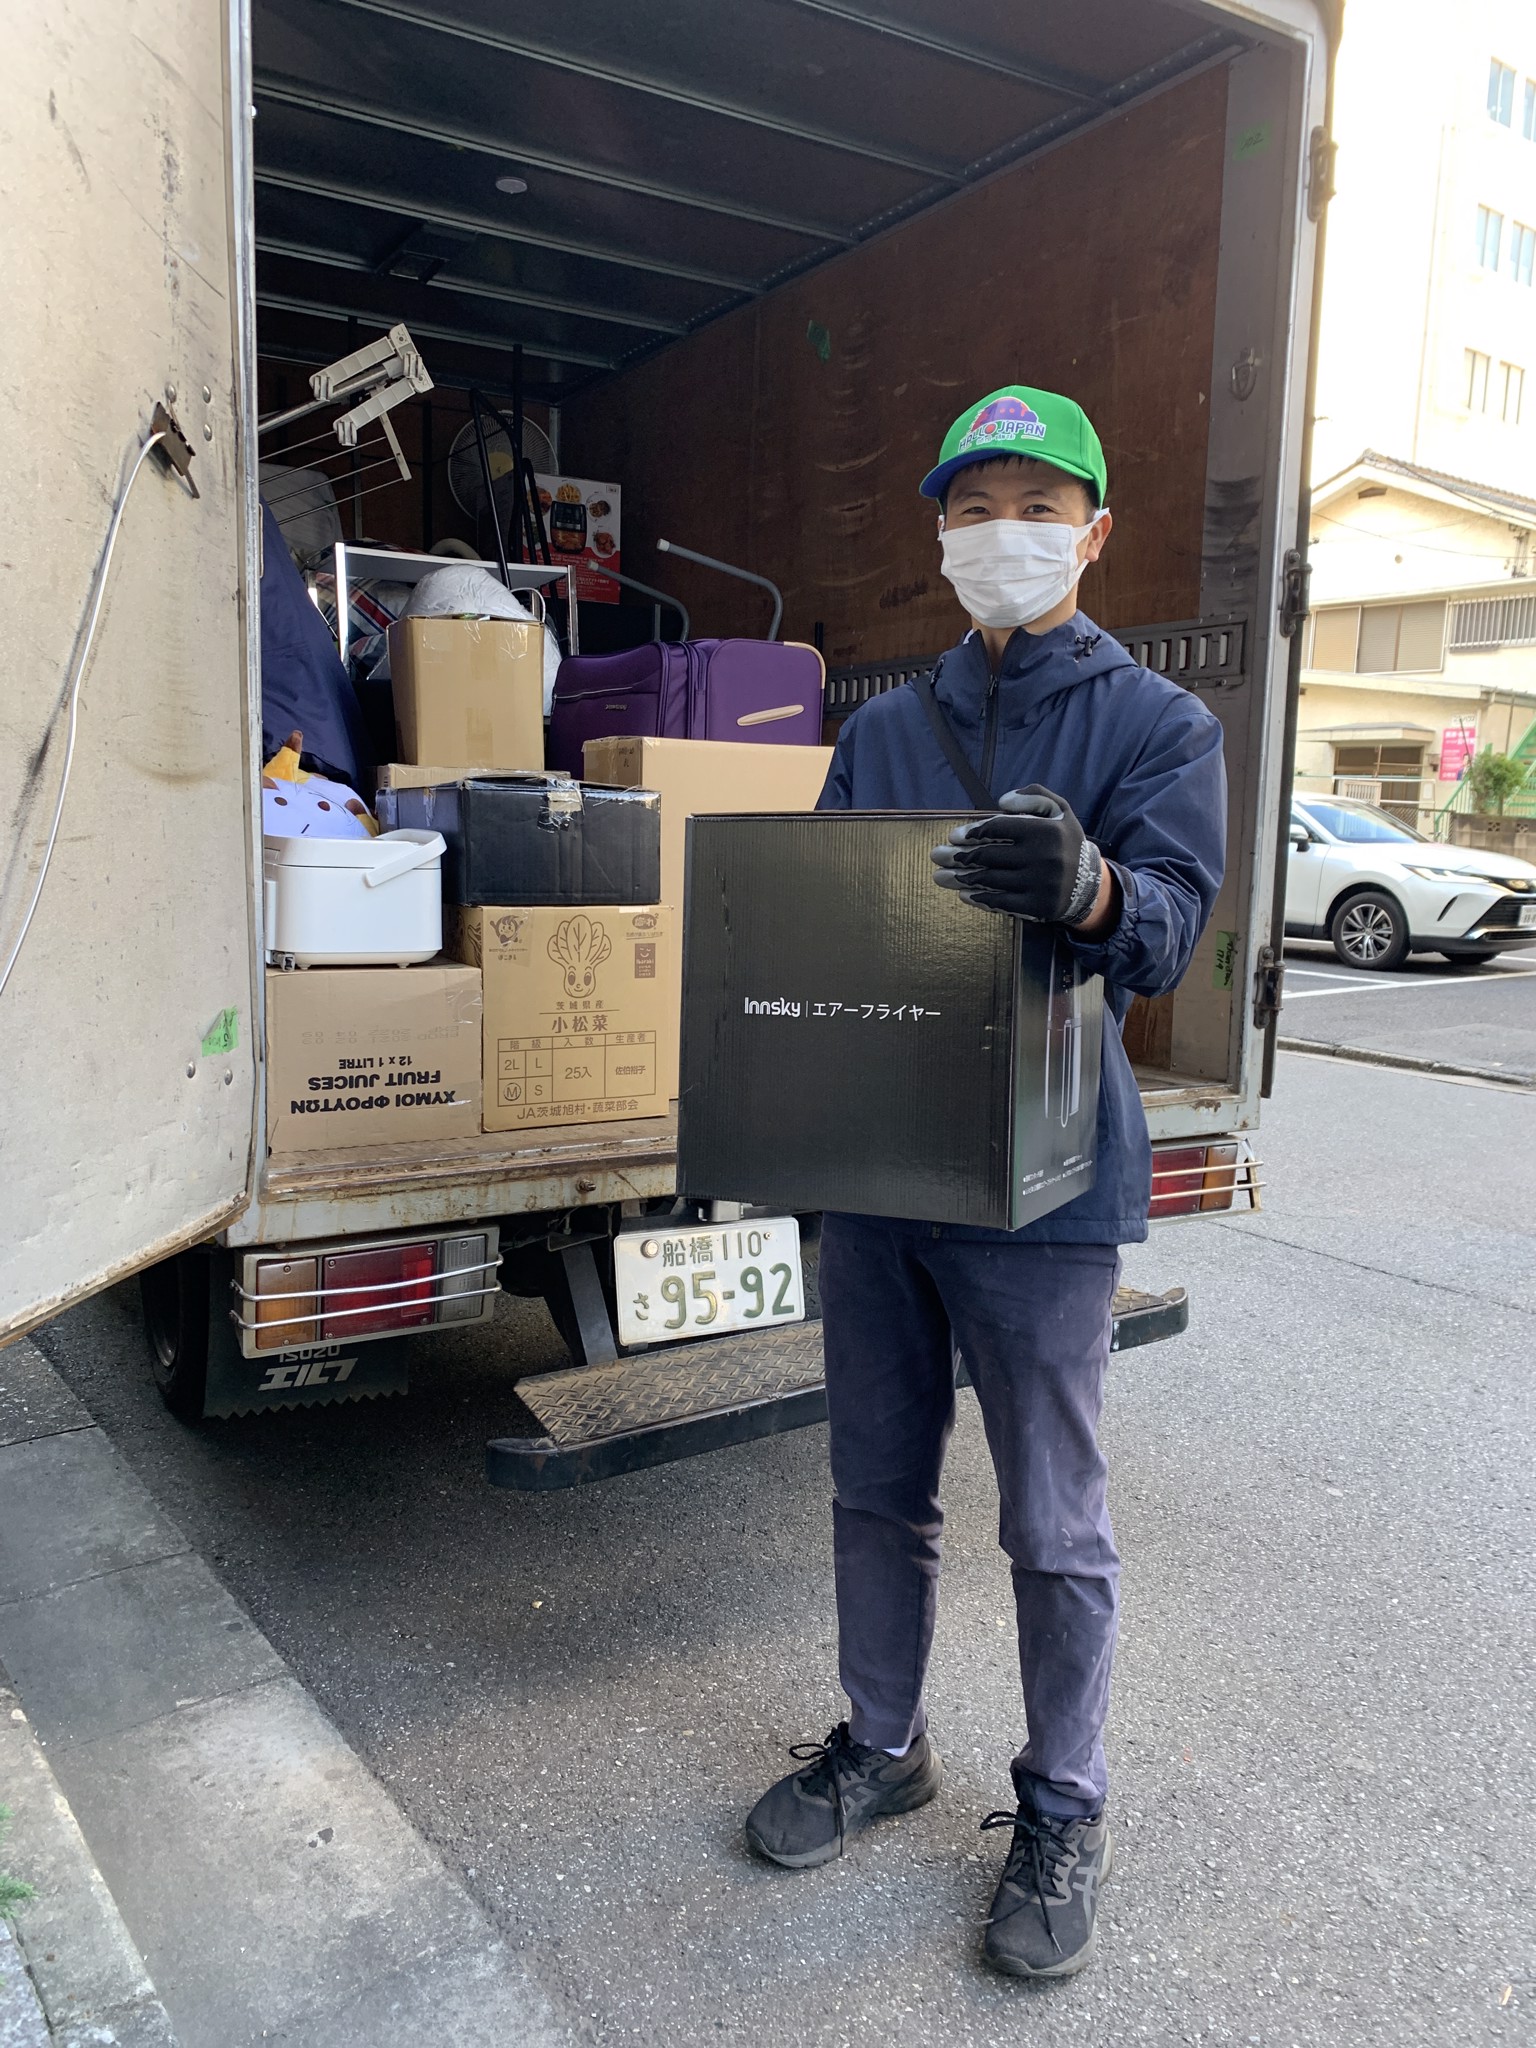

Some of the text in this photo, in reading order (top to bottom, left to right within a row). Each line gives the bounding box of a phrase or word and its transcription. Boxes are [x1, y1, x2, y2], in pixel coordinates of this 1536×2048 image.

[998, 421, 1045, 437] JAPAN
[556, 1000, 604, 1011] 茨城県産
[744, 997, 942, 1021] Innsky エアーフライヤー
[551, 1014, 609, 1034] 小松菜
[564, 1036, 594, 1047] 入数
[615, 1032, 647, 1043] 生産者
[338, 1058, 374, 1069] LITRE
[379, 1057, 384, 1067] 1
[398, 1056, 413, 1066] 12
[504, 1057, 543, 1071] 2L L
[308, 1070, 441, 1091] FRUIT JUICES
[564, 1067, 593, 1080] 25入
[506, 1085, 543, 1098] M S
[632, 1262, 794, 1329] さ 95-92
[258, 1357, 358, 1391] エルフ
